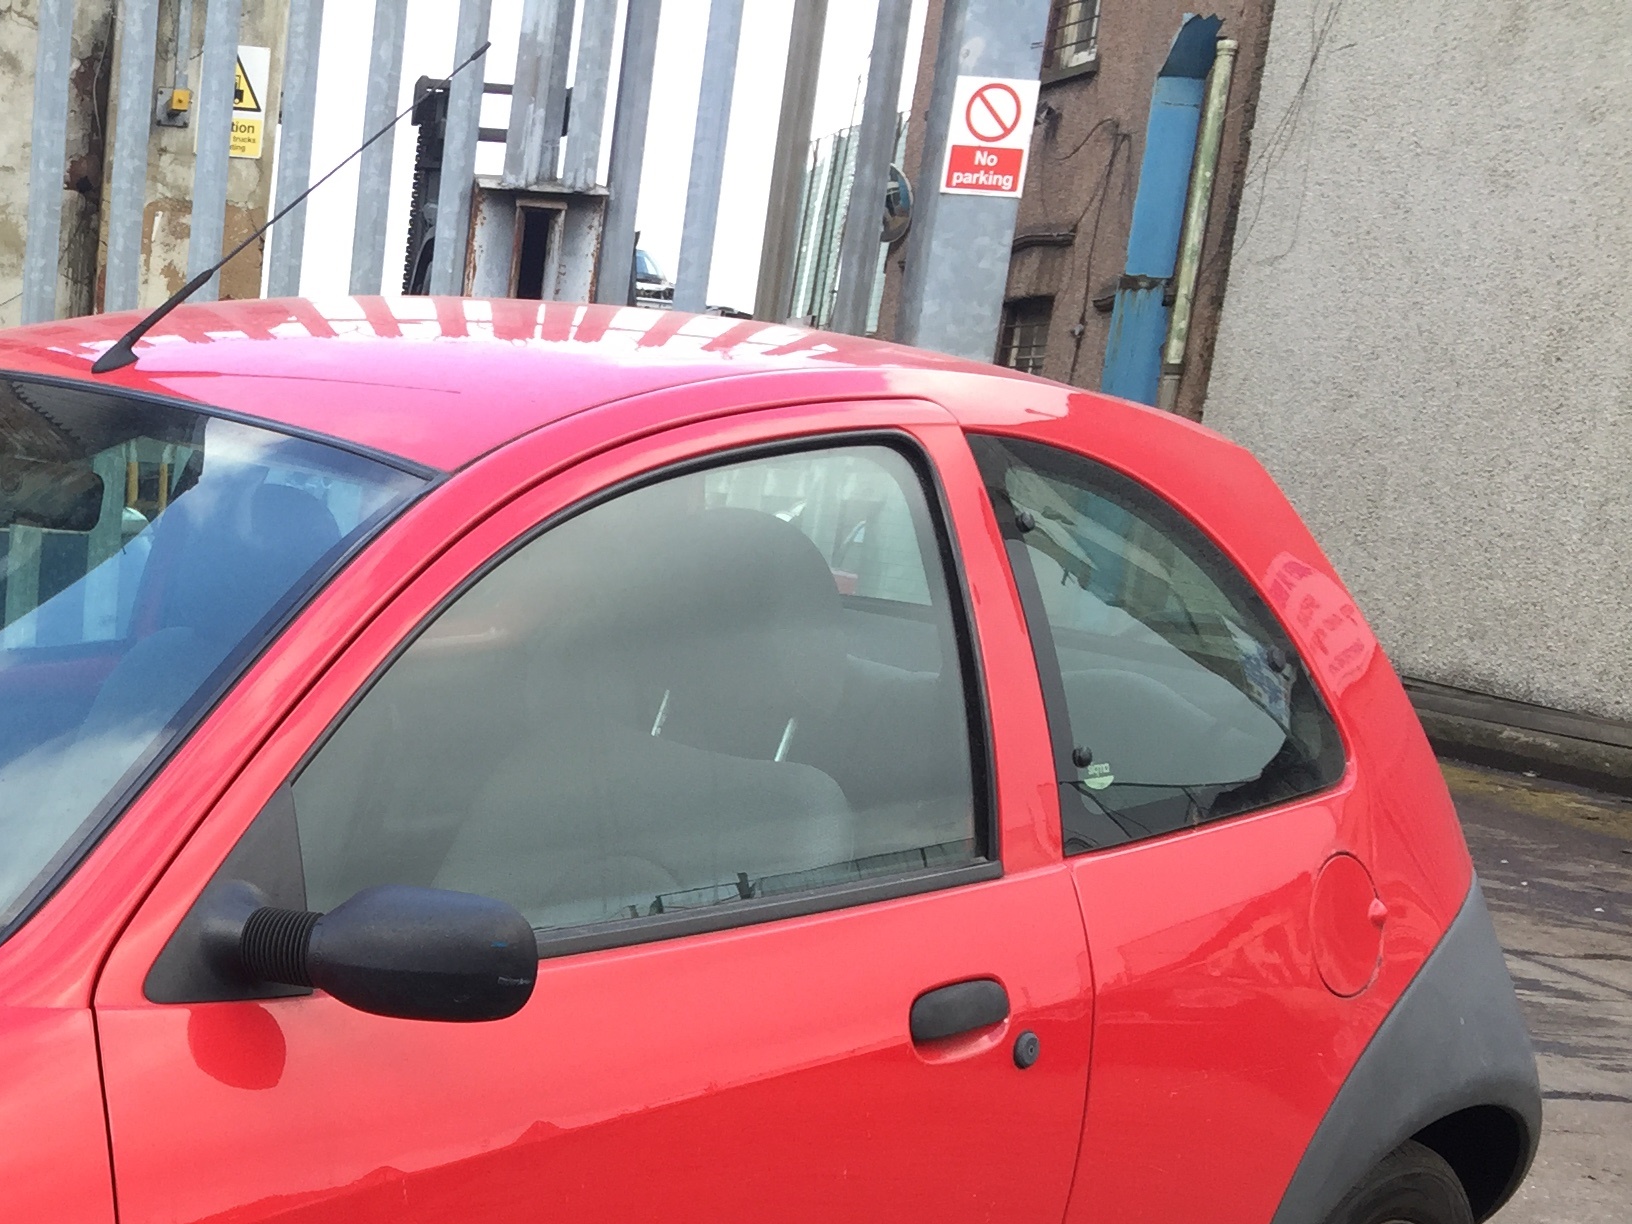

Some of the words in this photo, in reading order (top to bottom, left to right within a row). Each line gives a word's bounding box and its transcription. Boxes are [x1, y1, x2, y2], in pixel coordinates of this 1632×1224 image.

[231, 121, 255, 133] tion
[974, 151, 998, 166] No
[952, 170, 1013, 190] parking
